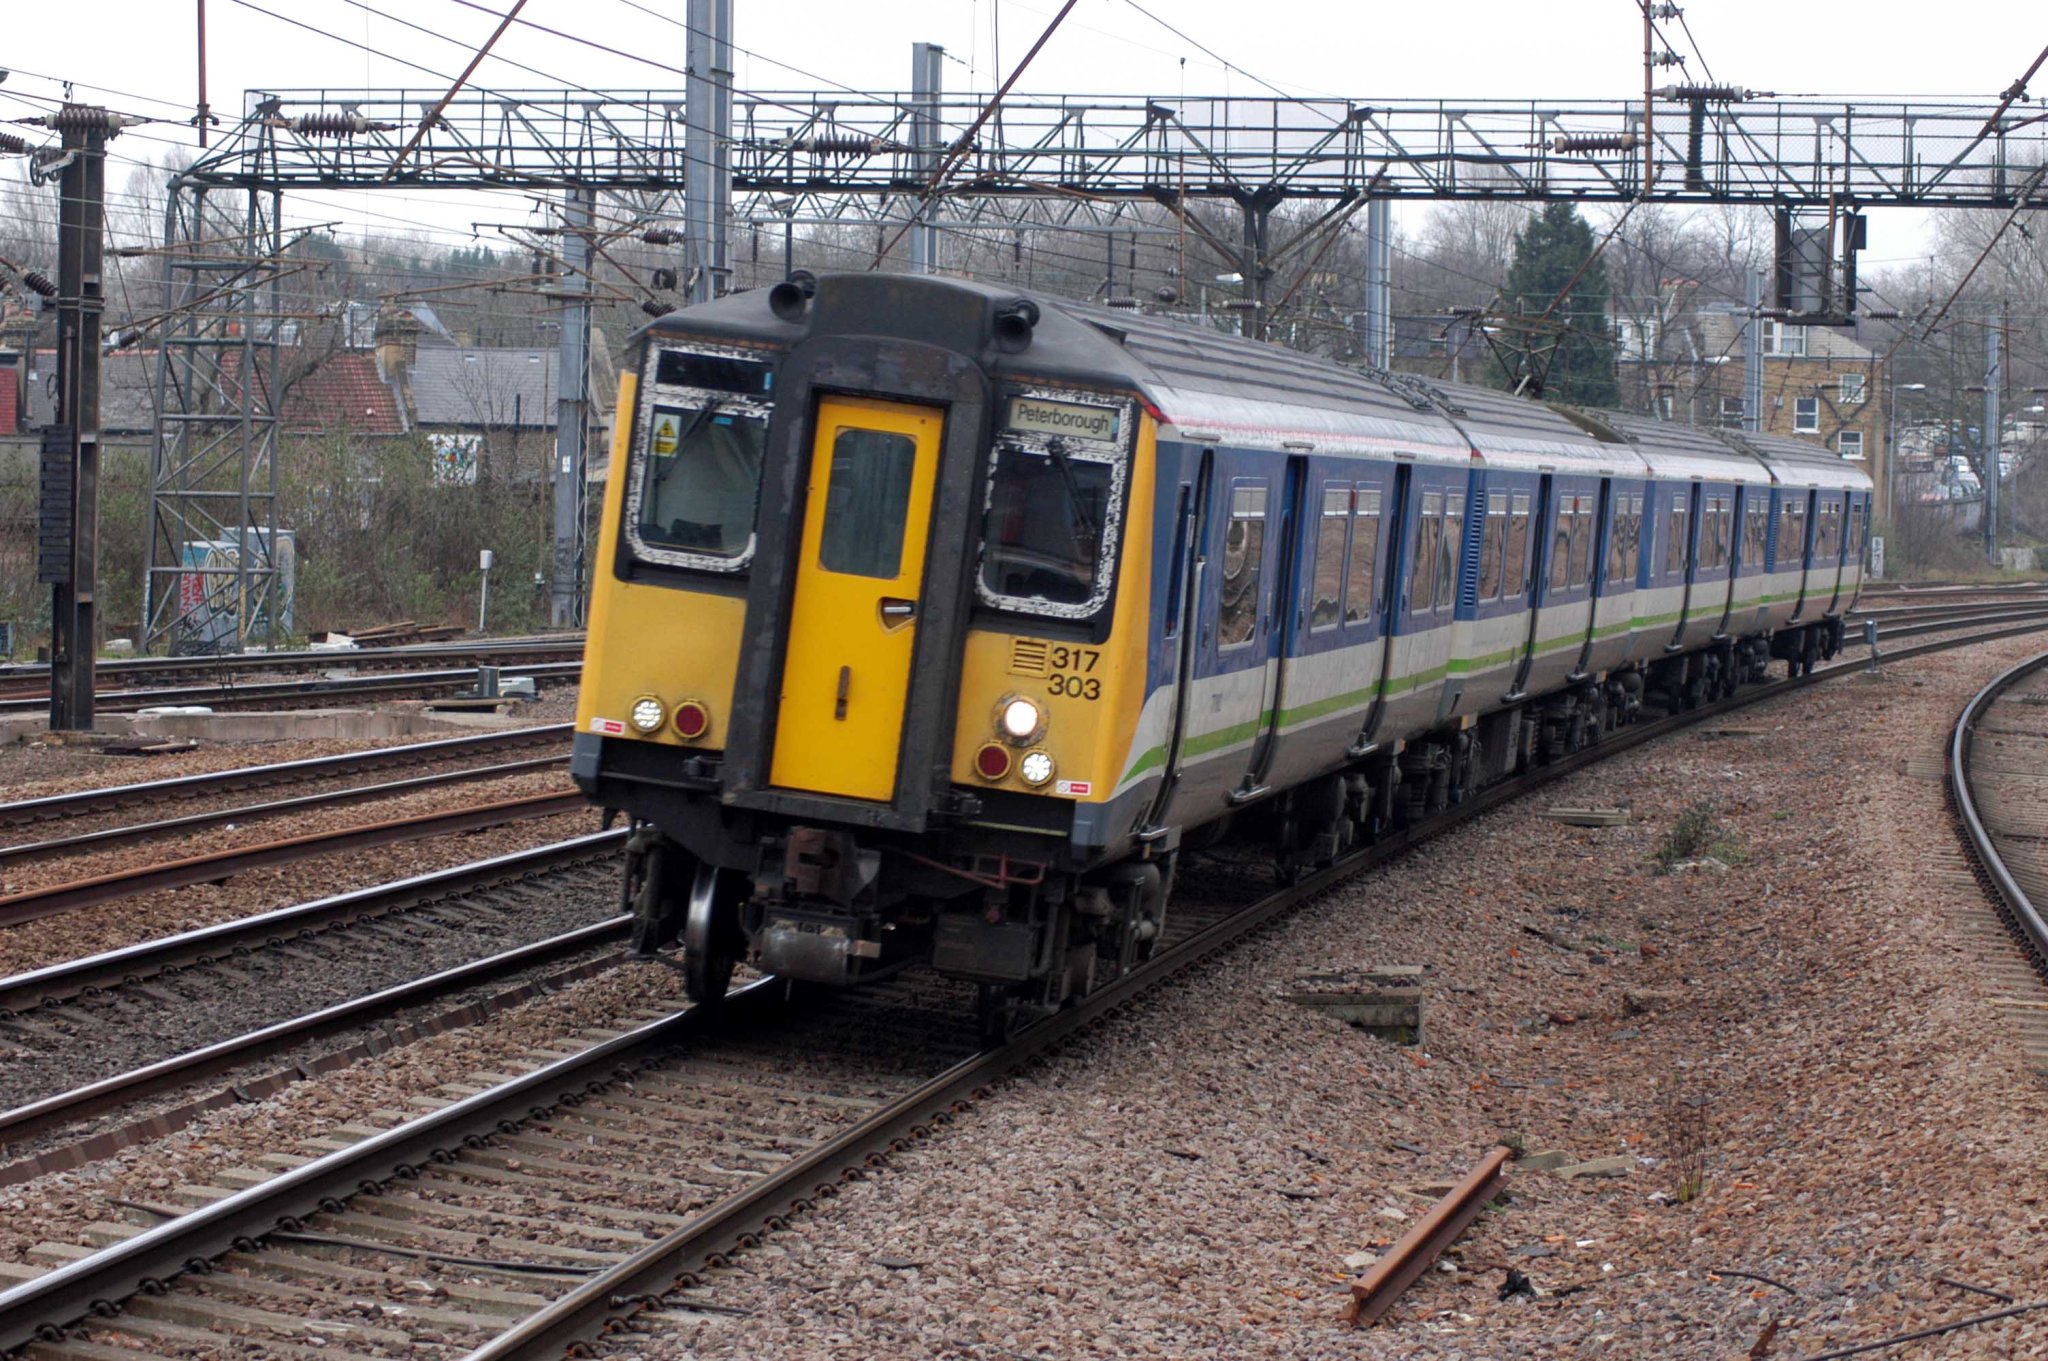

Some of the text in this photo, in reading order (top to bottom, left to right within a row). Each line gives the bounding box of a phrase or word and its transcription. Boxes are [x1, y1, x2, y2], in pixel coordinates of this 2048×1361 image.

[1017, 403, 1109, 434] Peterborough
[1052, 646, 1100, 672] 317
[1047, 673, 1101, 701] 303
